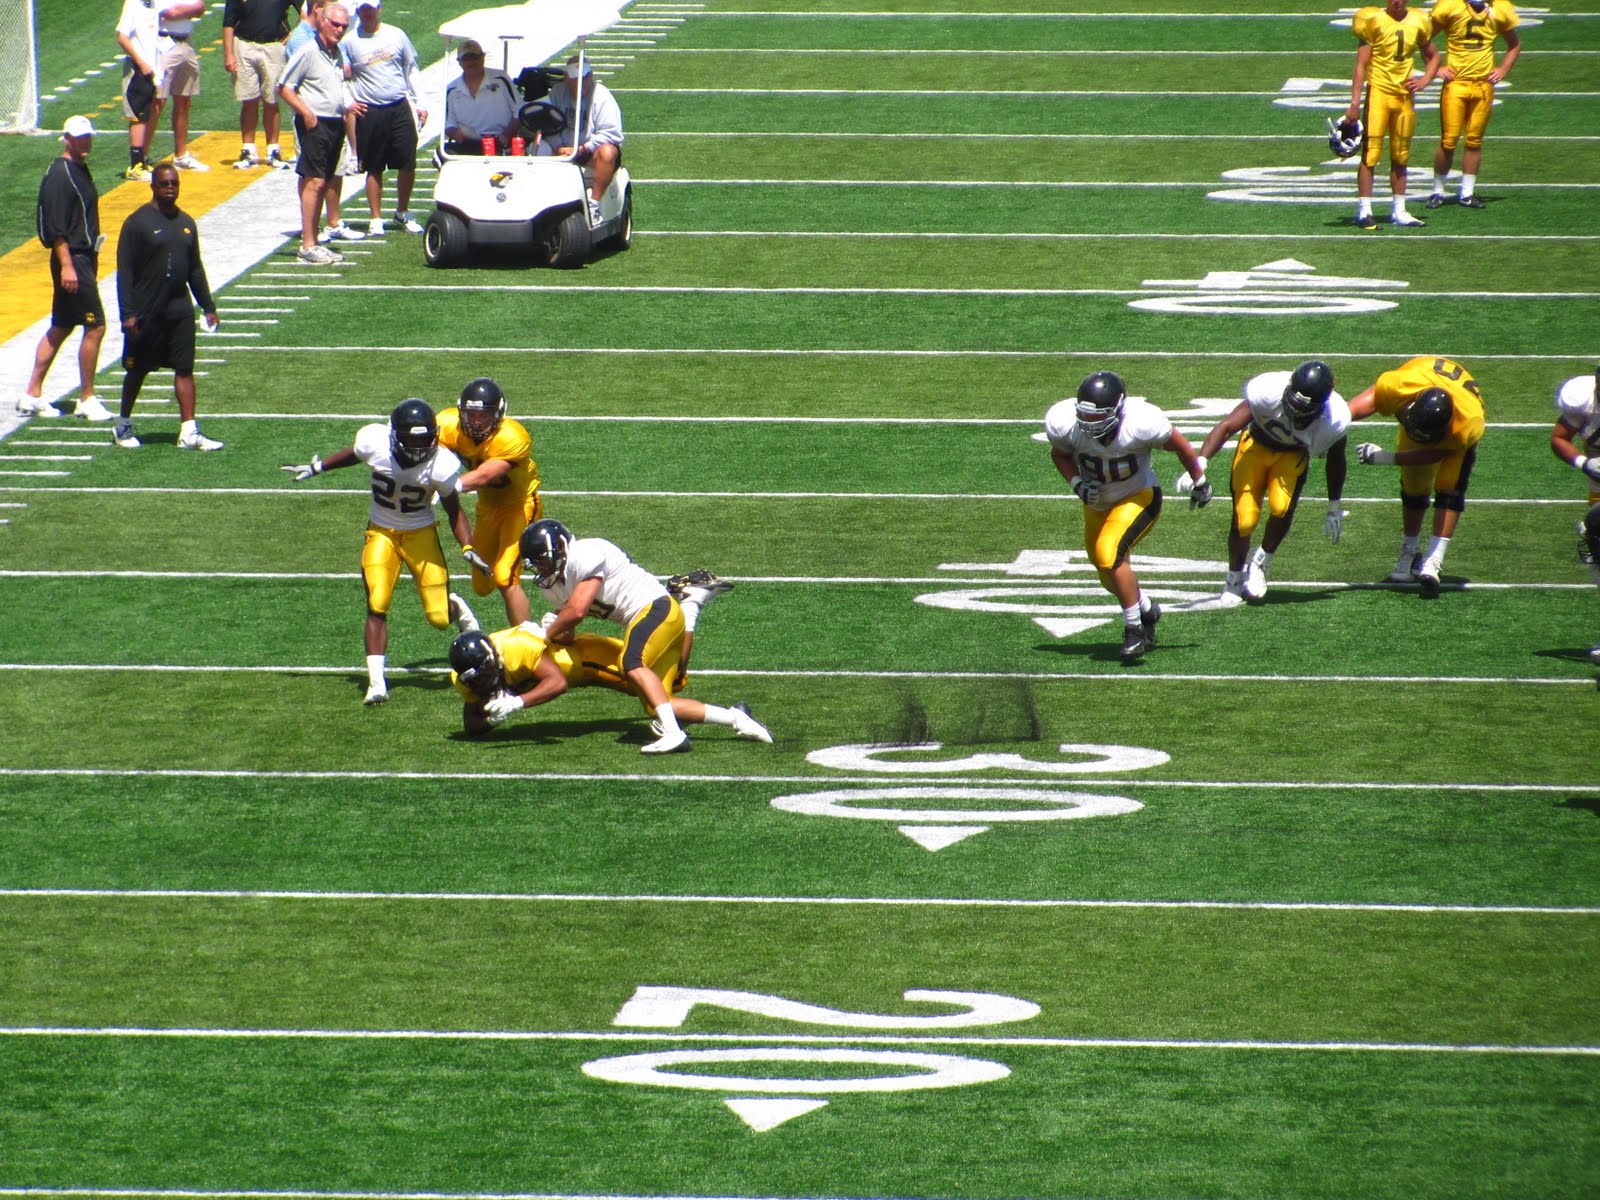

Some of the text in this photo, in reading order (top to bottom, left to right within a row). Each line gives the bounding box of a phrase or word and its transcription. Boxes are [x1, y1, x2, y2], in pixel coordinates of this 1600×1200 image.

[1393, 29, 1405, 62] 1
[1463, 19, 1486, 49] 5
[371, 471, 427, 513] 22
[770, 742, 1171, 822] 30
[581, 984, 1041, 1093] 20
